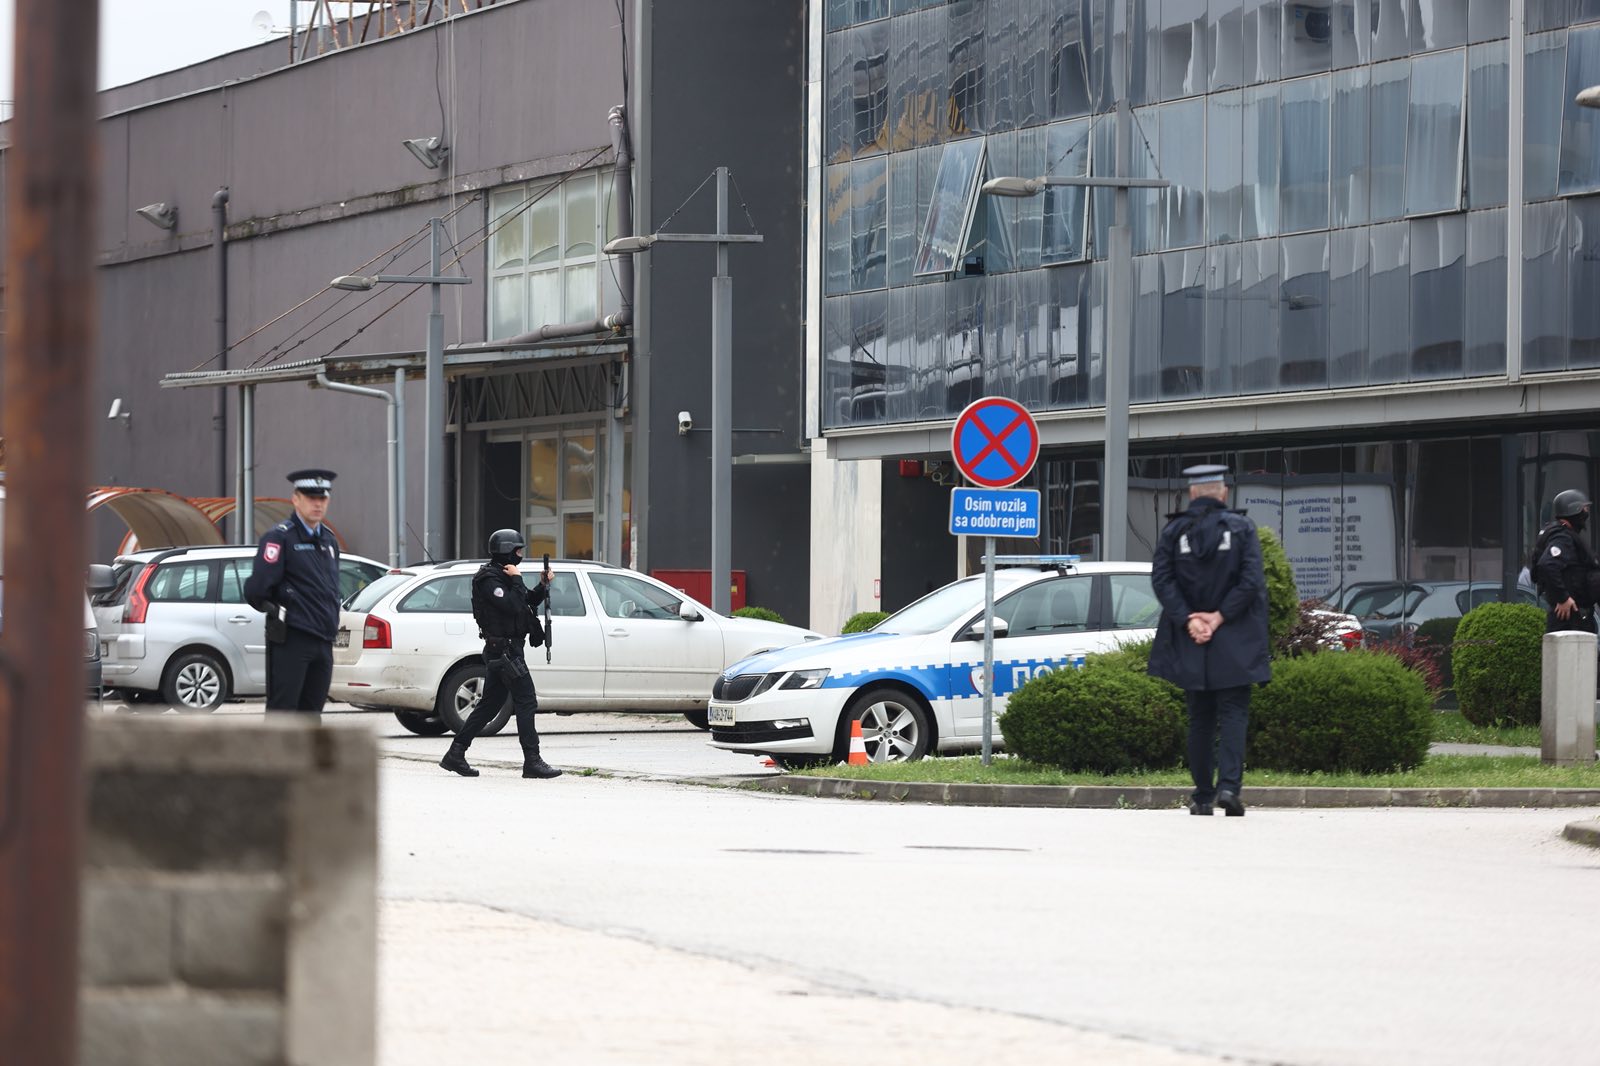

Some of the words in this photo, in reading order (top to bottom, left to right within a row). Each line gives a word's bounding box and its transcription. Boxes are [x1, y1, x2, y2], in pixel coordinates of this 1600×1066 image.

[965, 496, 992, 511] Osim
[995, 497, 1027, 512] vozila
[954, 515, 968, 527] sa
[970, 513, 1036, 532] odobrenjem
